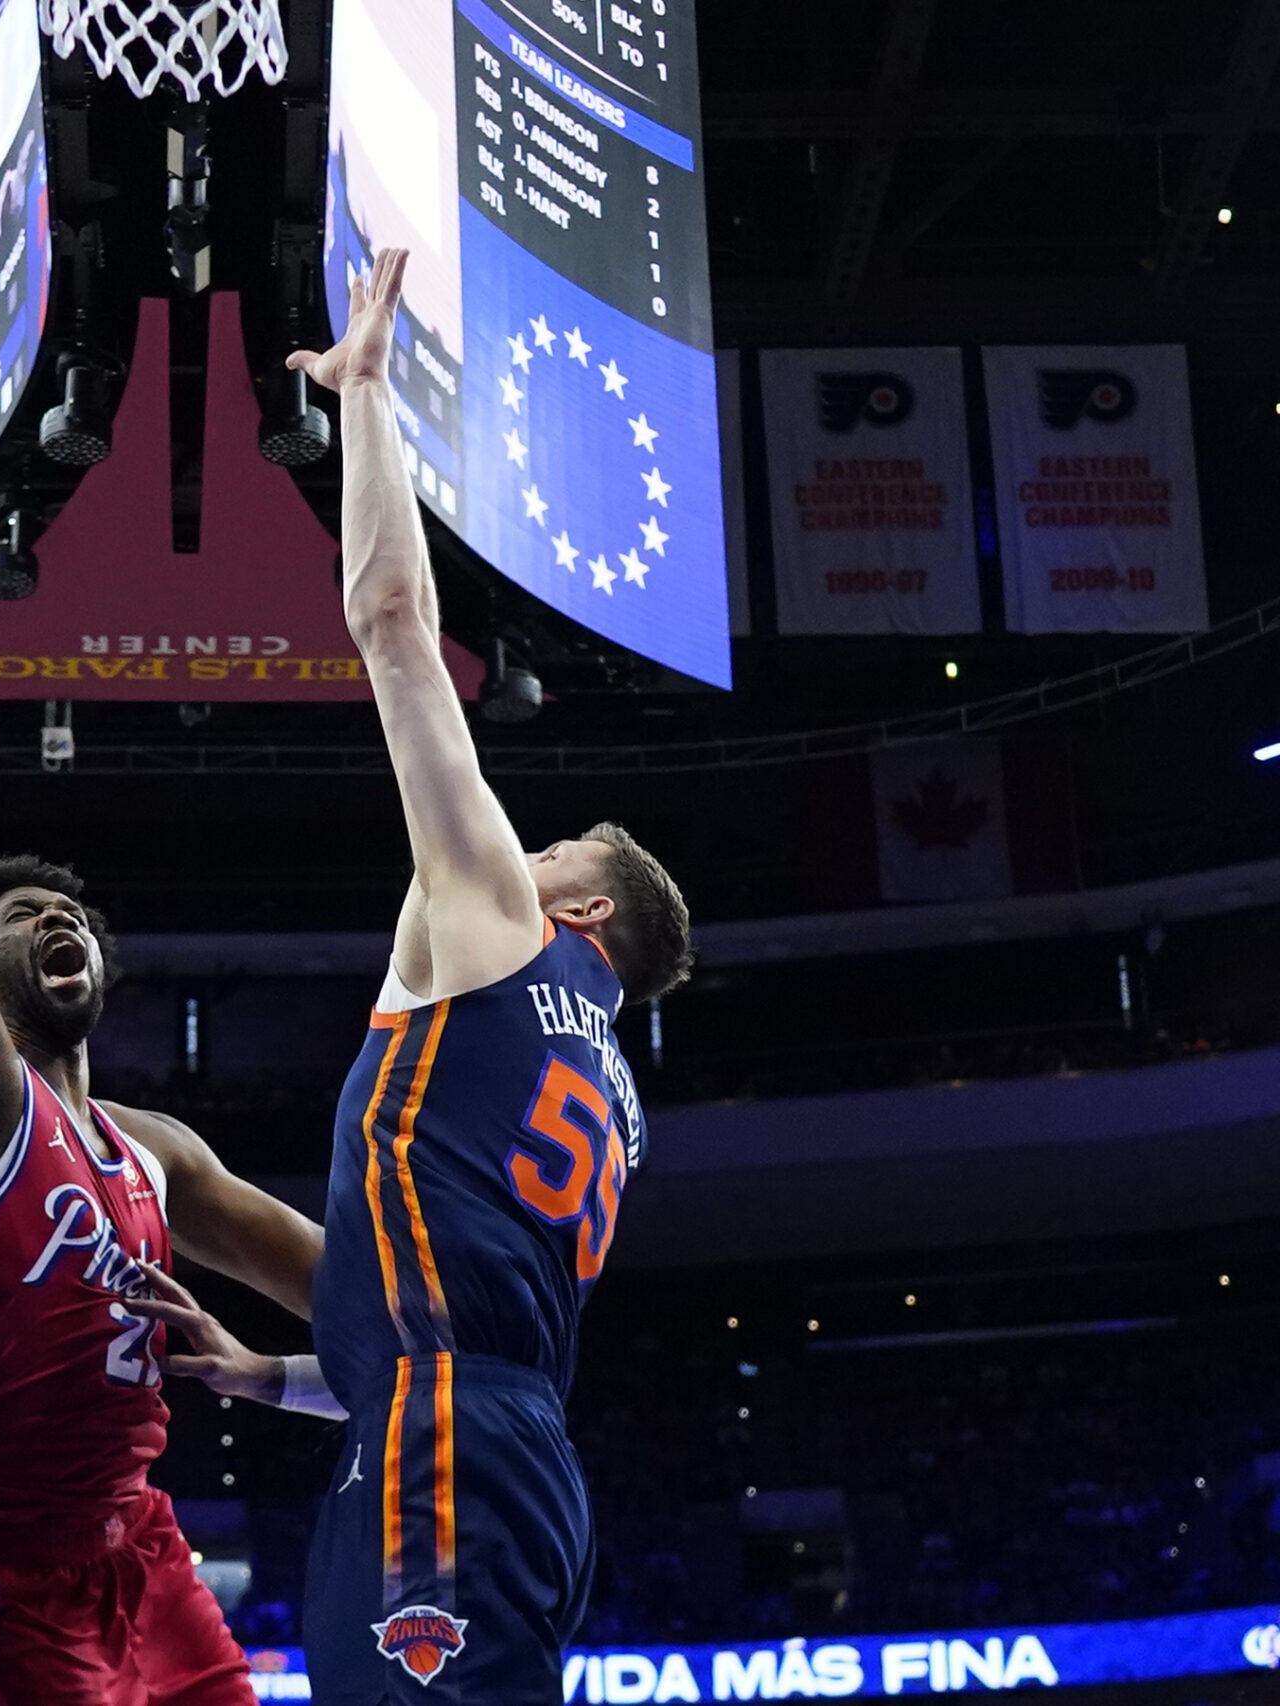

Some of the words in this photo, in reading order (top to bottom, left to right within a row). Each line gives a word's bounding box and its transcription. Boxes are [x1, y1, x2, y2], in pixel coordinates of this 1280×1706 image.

[552, 0, 587, 34] 50%
[610, 3, 643, 37] BLK
[654, 30, 665, 49] 1
[509, 33, 554, 83] TEAM
[554, 68, 626, 128] LEADERS
[618, 39, 644, 68] TO
[656, 63, 668, 82] 1
[475, 43, 501, 79] PTS
[511, 77, 523, 99] J.
[524, 86, 599, 152] BRUNSON
[646, 165, 659, 185] 8
[475, 76, 502, 112] REB
[512, 111, 529, 135] O.
[530, 125, 608, 188] ANUNOBY
[647, 197, 661, 219] 2
[475, 111, 503, 145] AST
[514, 143, 526, 166] J.
[527, 152, 602, 219] BRUNSON
[648, 230, 659, 250] 1
[478, 144, 505, 181] BLK
[515, 177, 528, 200] J.
[528, 186, 570, 230] HART
[650, 263, 661, 283] 1
[480, 181, 507, 216] STL
[652, 296, 667, 317] 0
[814, 459, 924, 481] EASTERN
[1038, 456, 1151, 477] EASTERN
[800, 508, 944, 531] CHAMPIONS
[1025, 505, 1171, 529] CHAMPIONS
[81, 634, 291, 656] CENTER
[189, 657, 370, 681] ELLS
[382, 1615, 462, 1649] KNICKS
[712, 1637, 864, 1698] MÁS
[881, 1634, 1059, 1695] FINA
